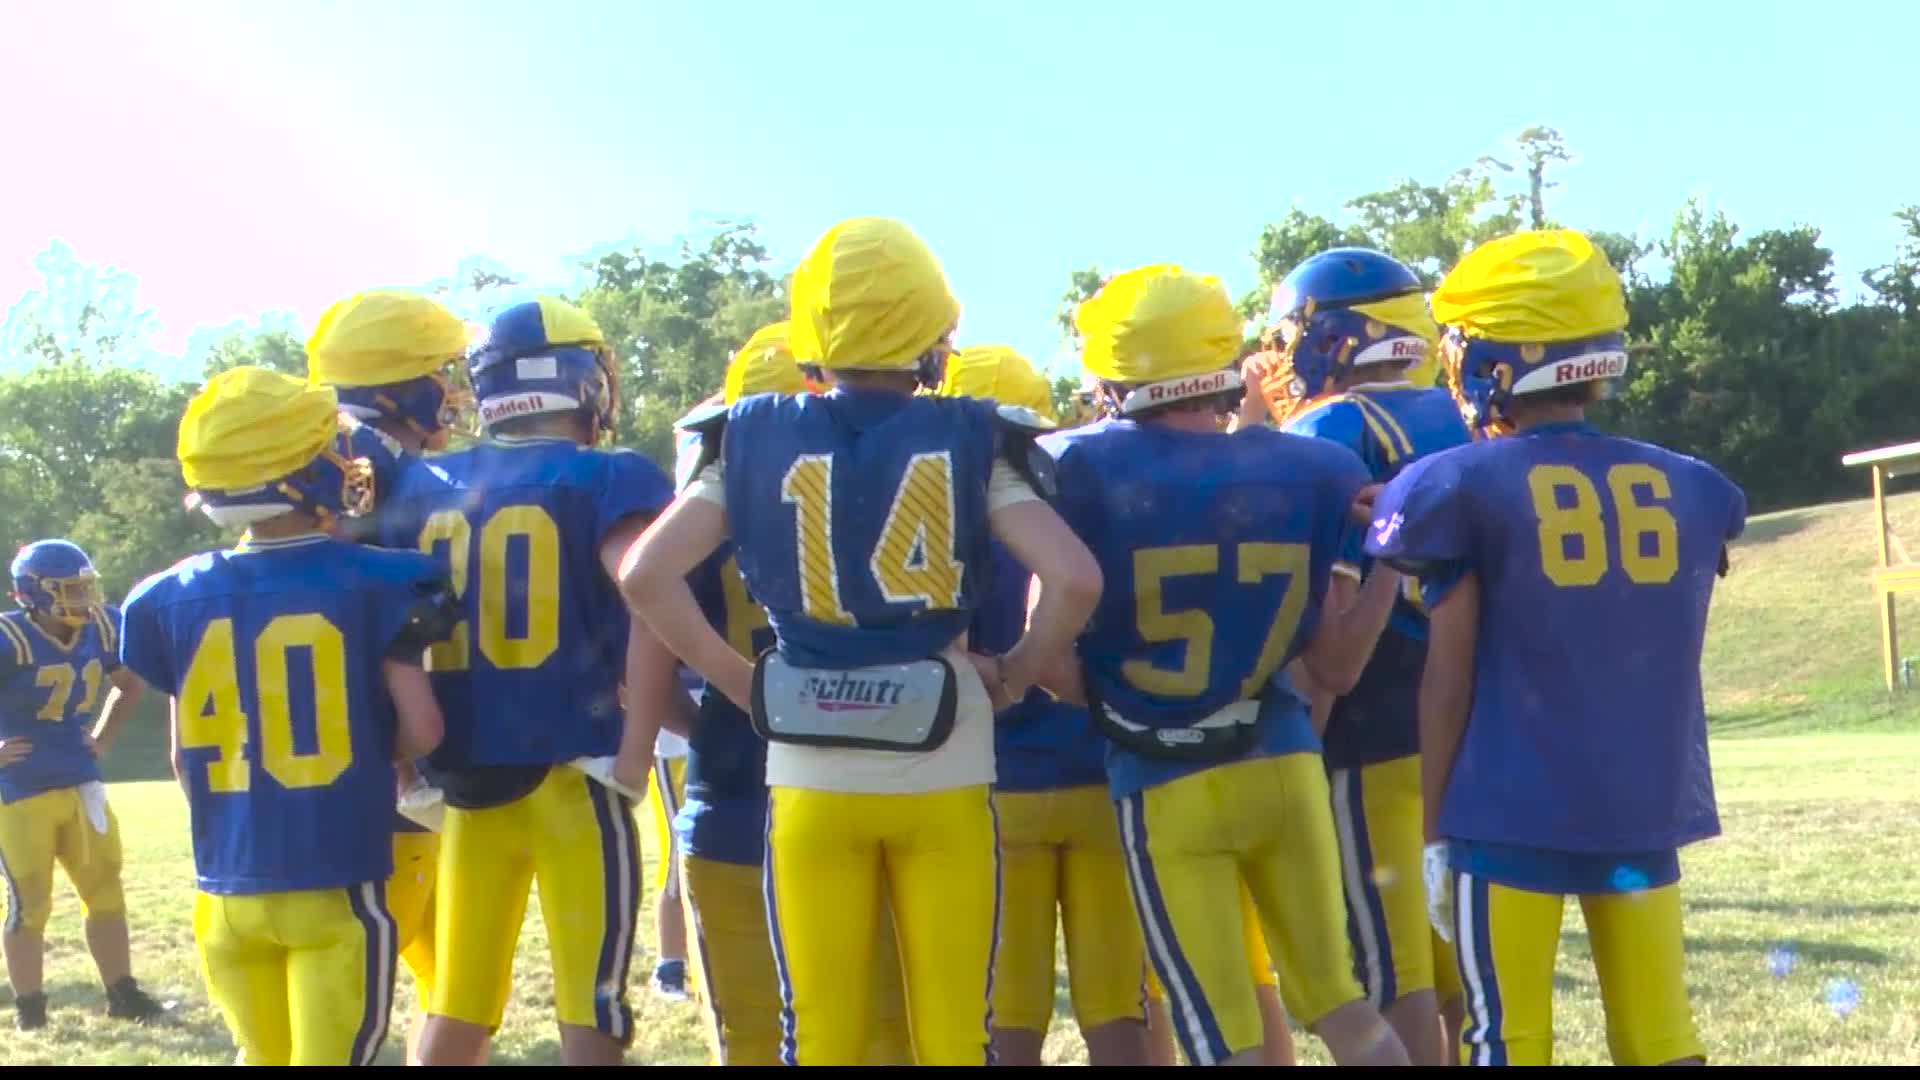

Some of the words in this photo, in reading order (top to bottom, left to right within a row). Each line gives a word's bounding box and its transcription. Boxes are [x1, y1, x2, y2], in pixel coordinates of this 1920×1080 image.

[482, 395, 544, 421] Riddell
[1149, 373, 1225, 400] Riddell
[418, 505, 560, 671] 20
[780, 451, 964, 628] 14
[1528, 463, 1679, 587] 86
[35, 658, 103, 722] 71
[1120, 541, 1311, 699] 57
[178, 612, 353, 790] 40
